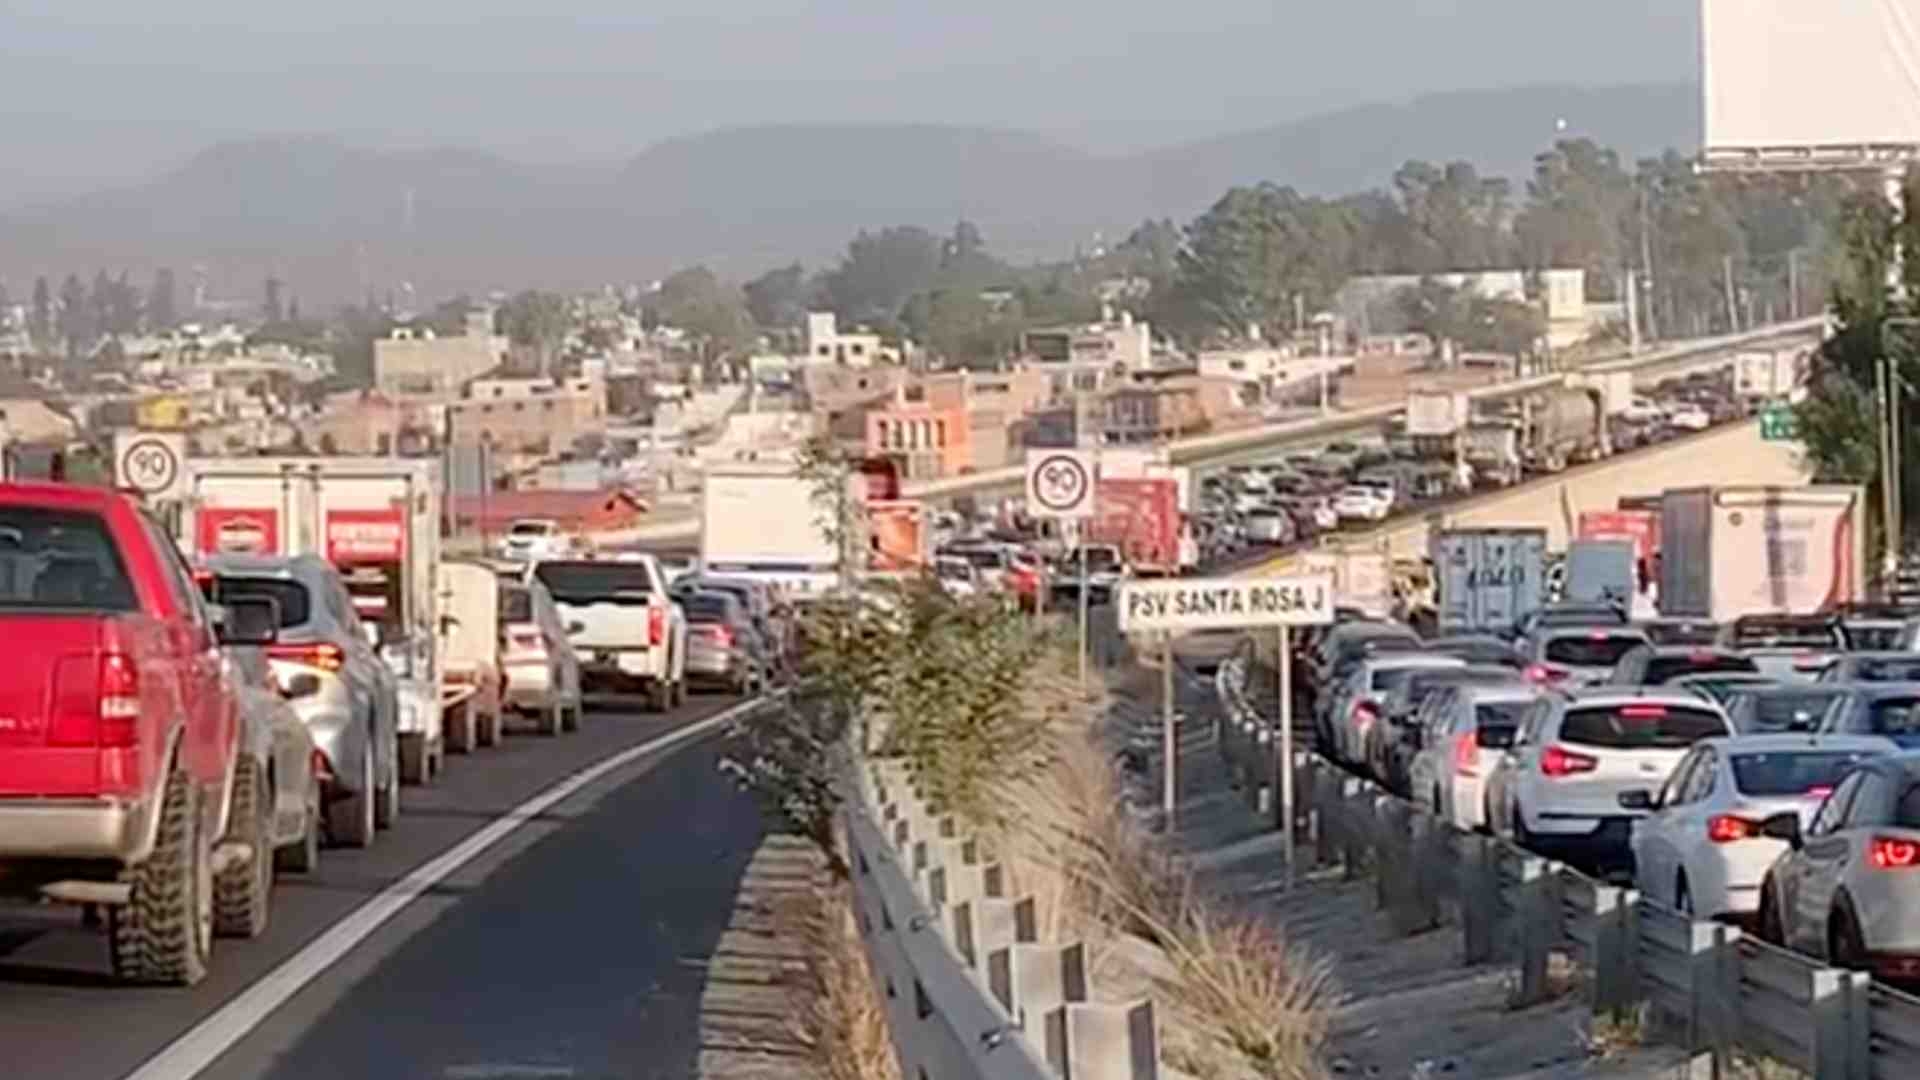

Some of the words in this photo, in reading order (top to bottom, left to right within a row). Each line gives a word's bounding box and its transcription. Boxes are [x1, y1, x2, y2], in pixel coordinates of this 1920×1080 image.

[135, 451, 165, 477] 90
[1045, 466, 1076, 492] 90
[1130, 591, 1168, 617] PSV
[1174, 588, 1243, 614] SANTA
[1250, 586, 1306, 612] ROSA
